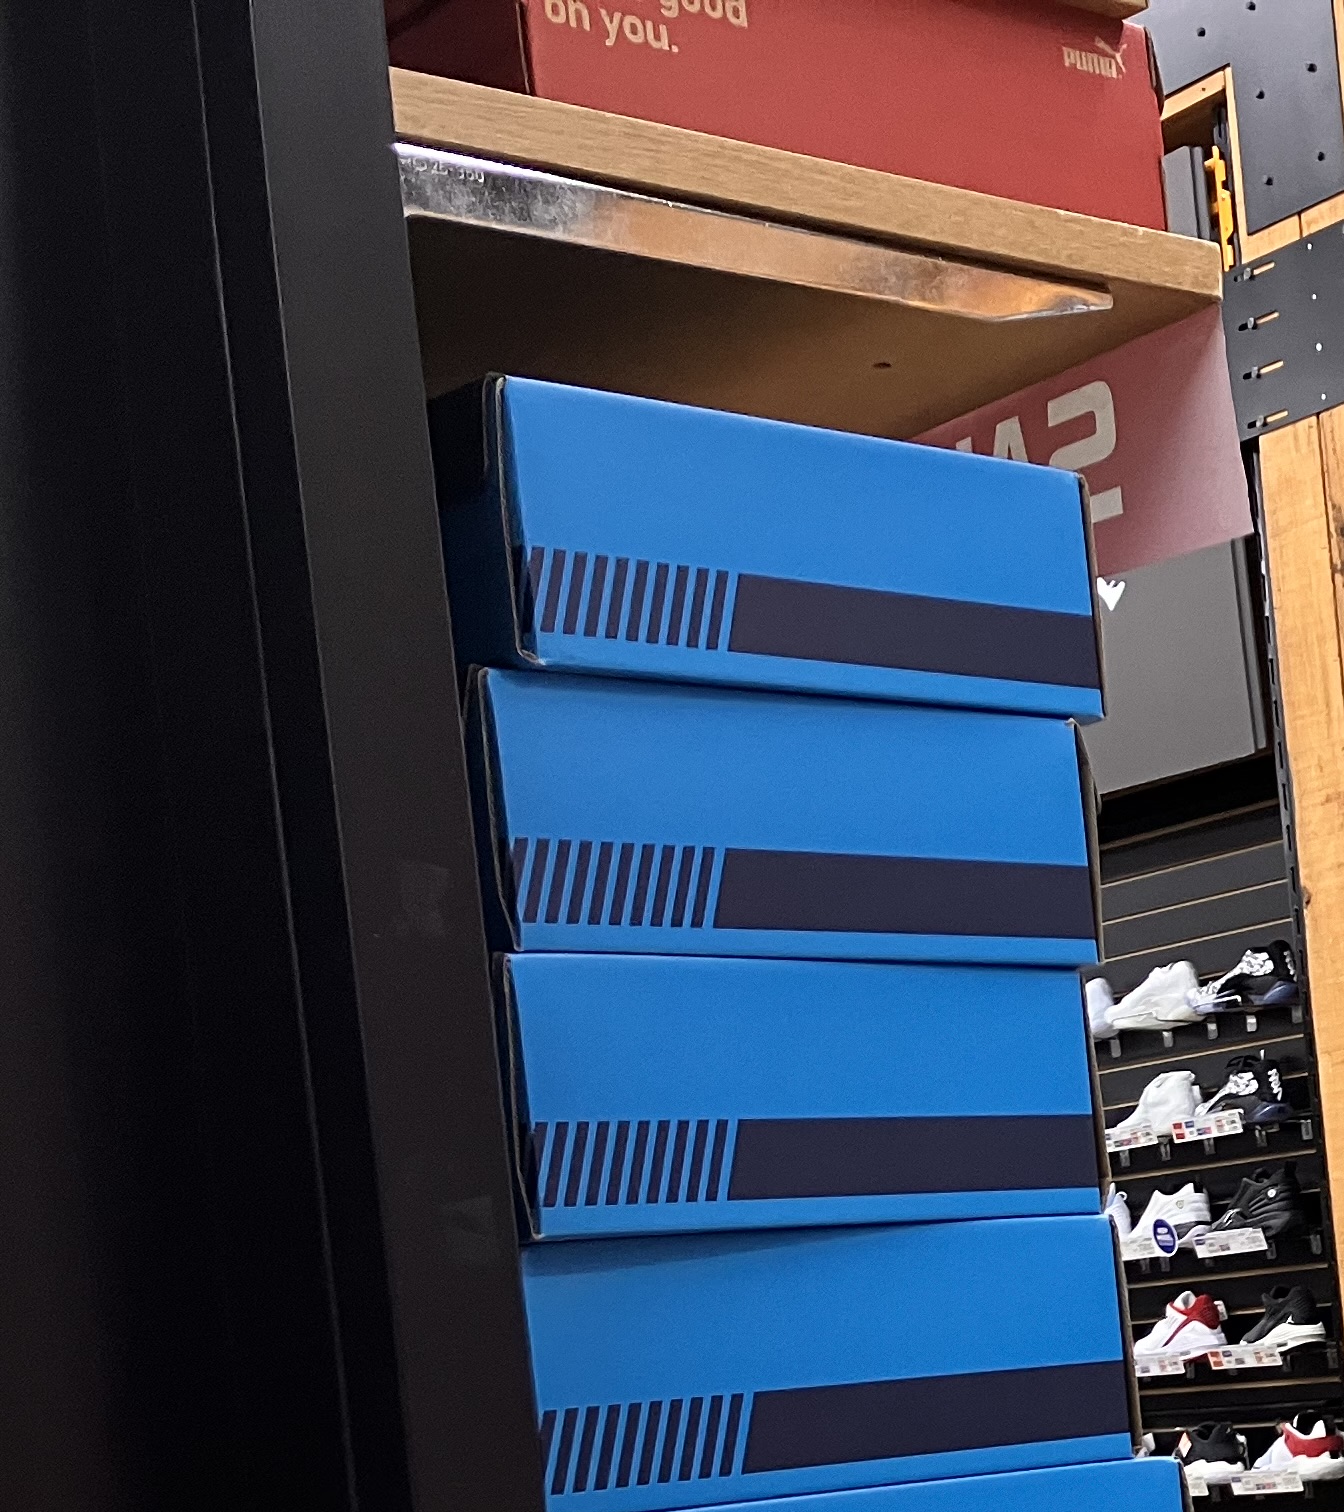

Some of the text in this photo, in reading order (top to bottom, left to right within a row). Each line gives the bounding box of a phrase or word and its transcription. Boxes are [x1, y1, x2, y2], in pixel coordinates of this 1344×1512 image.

[545, 0, 679, 53] on you.
[1063, 45, 1124, 77] PUMA
